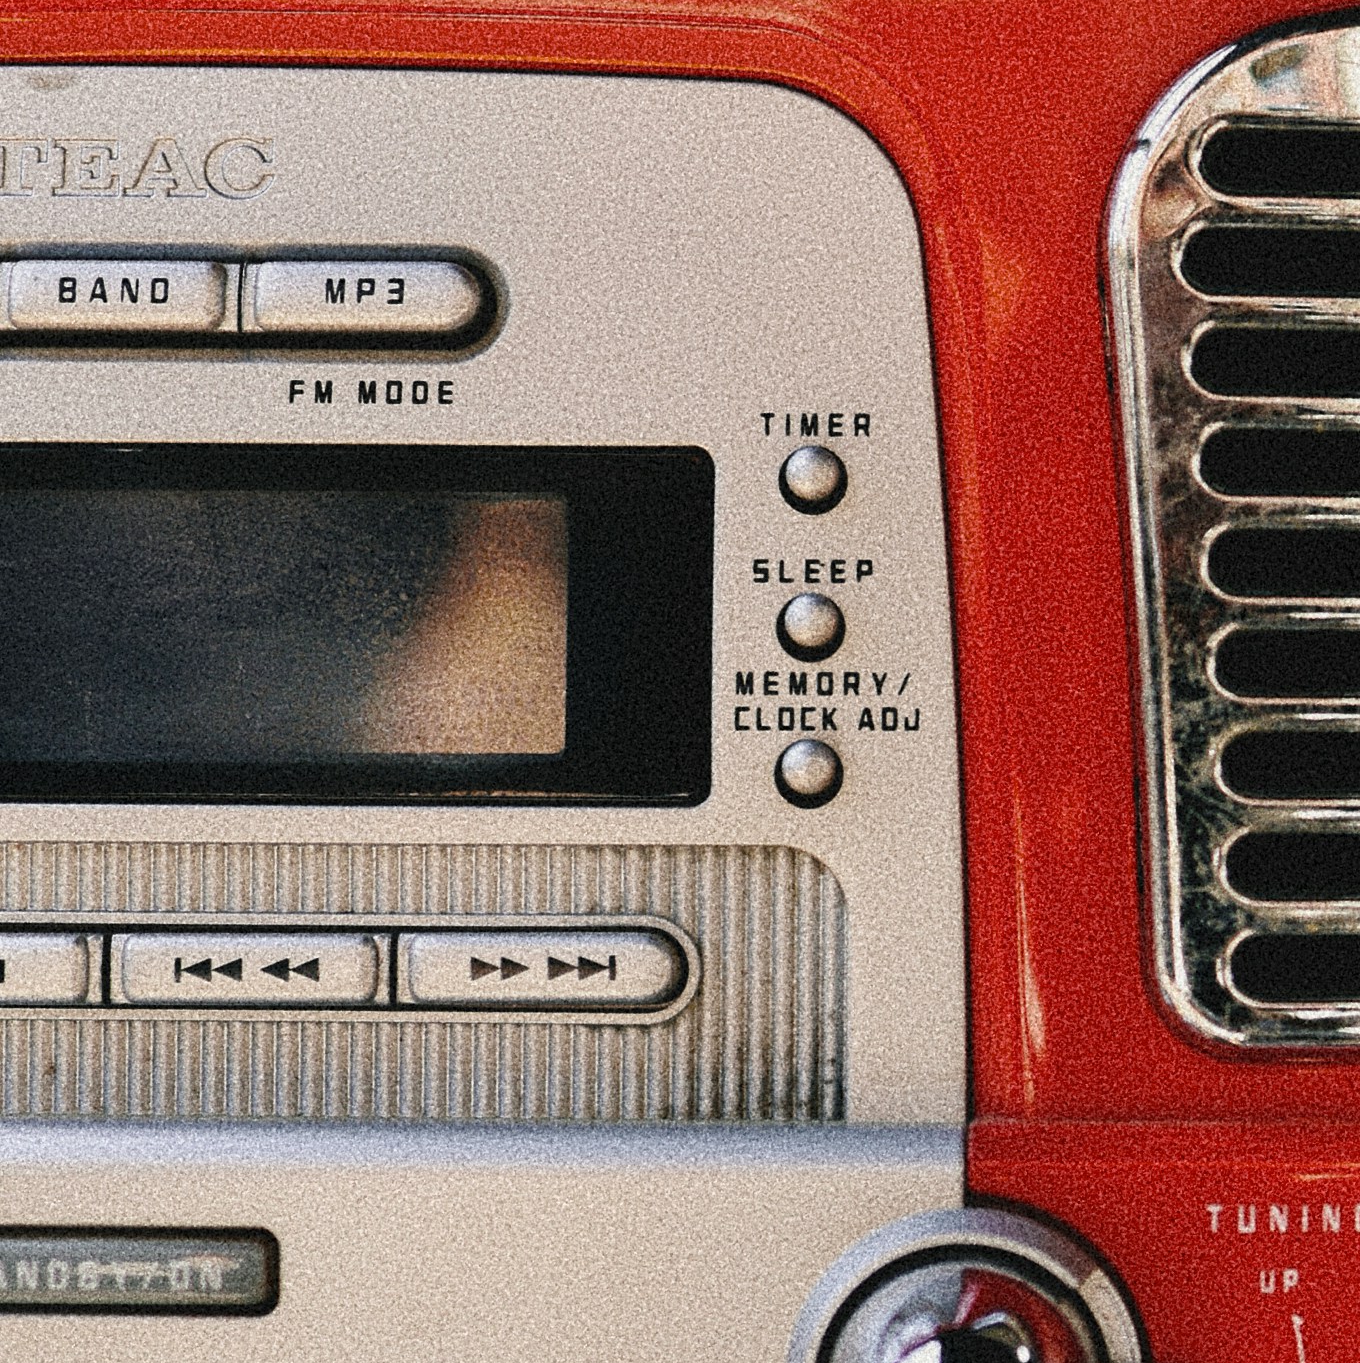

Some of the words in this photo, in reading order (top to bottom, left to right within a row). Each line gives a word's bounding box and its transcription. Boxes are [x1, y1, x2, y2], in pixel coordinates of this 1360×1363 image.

[0, 137, 275, 200] TEAC
[58, 277, 169, 304] BAND
[325, 277, 406, 305] MP3
[289, 380, 334, 404] FM
[358, 380, 454, 404] MODE
[760, 412, 871, 437] TIMER
[753, 559, 874, 583] SLEEP
[735, 671, 911, 695] MEMORY/
[734, 706, 838, 731] CLOCK
[858, 706, 920, 731] ADJ
[1259, 1268, 1299, 1293] UP
